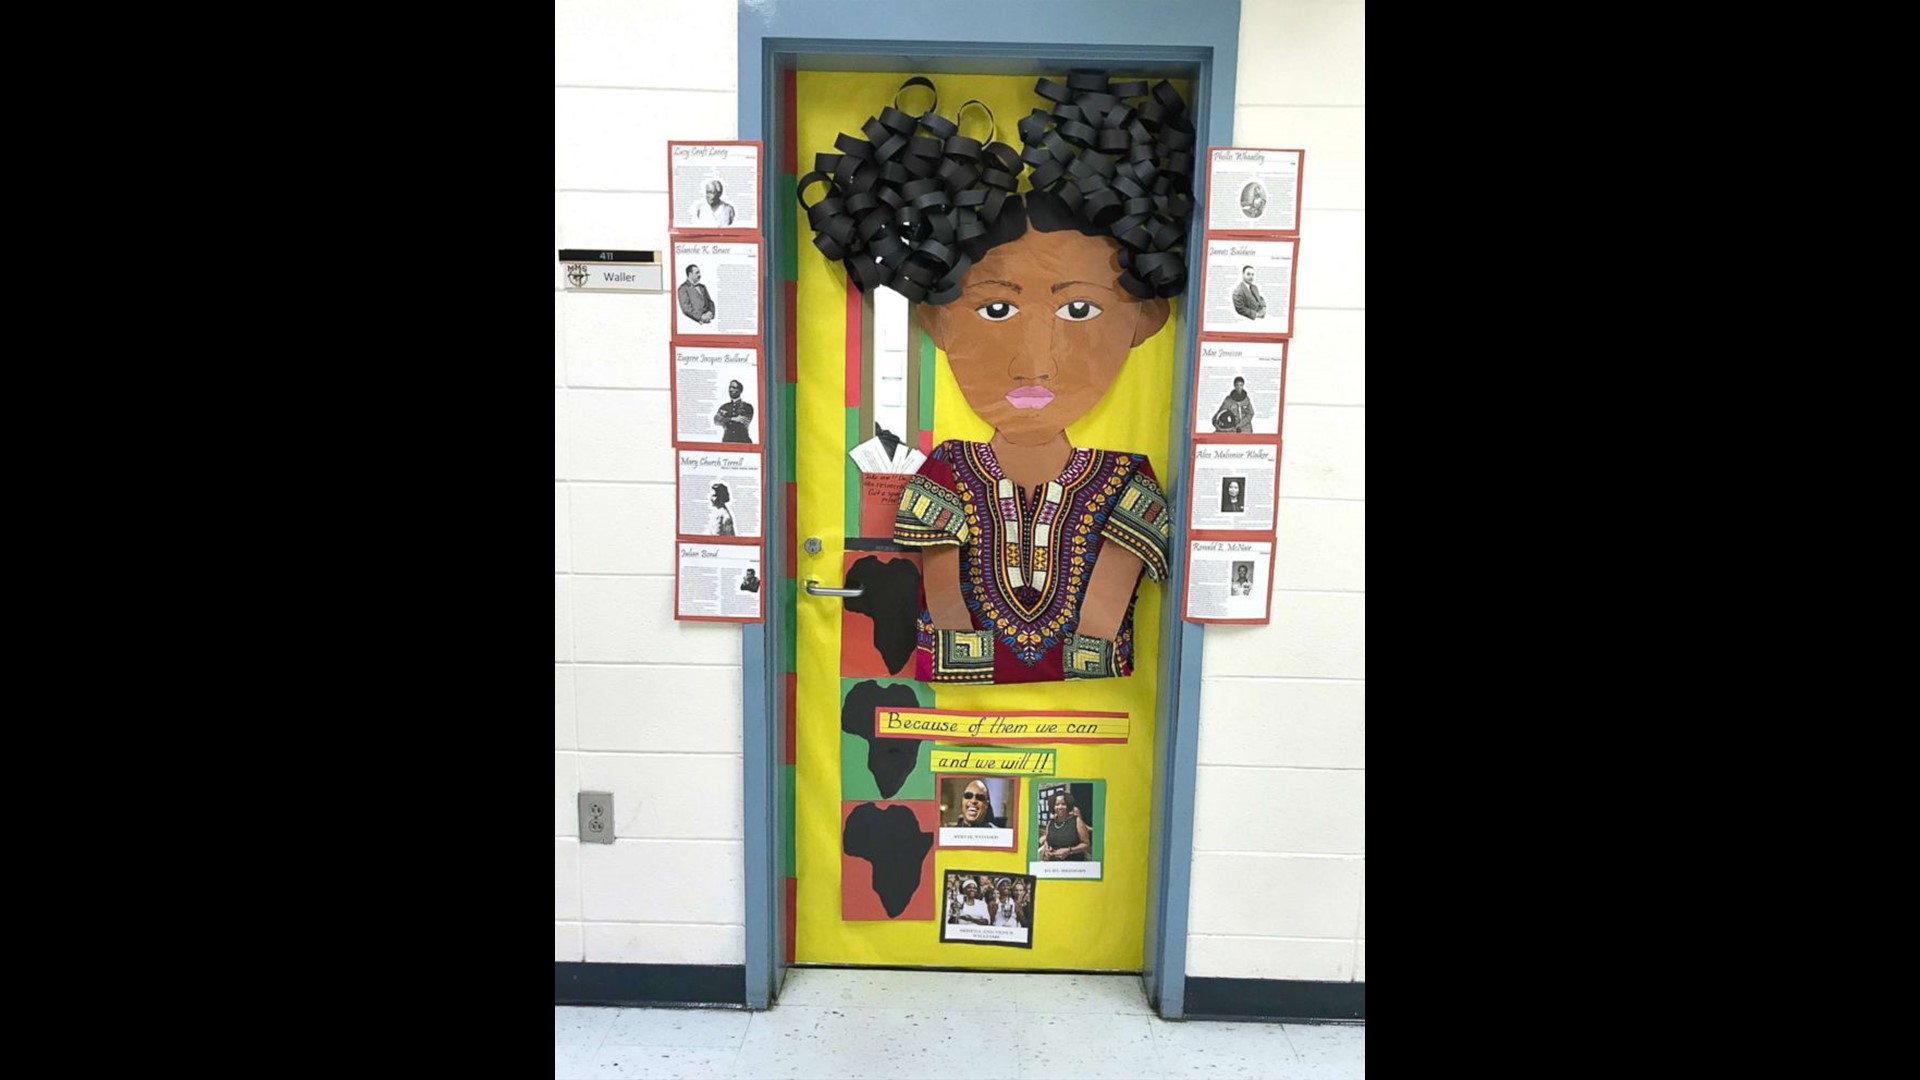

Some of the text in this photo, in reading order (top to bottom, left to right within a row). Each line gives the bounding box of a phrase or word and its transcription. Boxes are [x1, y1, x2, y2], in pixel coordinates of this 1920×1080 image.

[600, 252, 614, 260] 411
[603, 272, 636, 282] Waller
[888, 711, 1099, 737] Because of them we can
[938, 752, 971, 769] and
[975, 759, 996, 769] we
